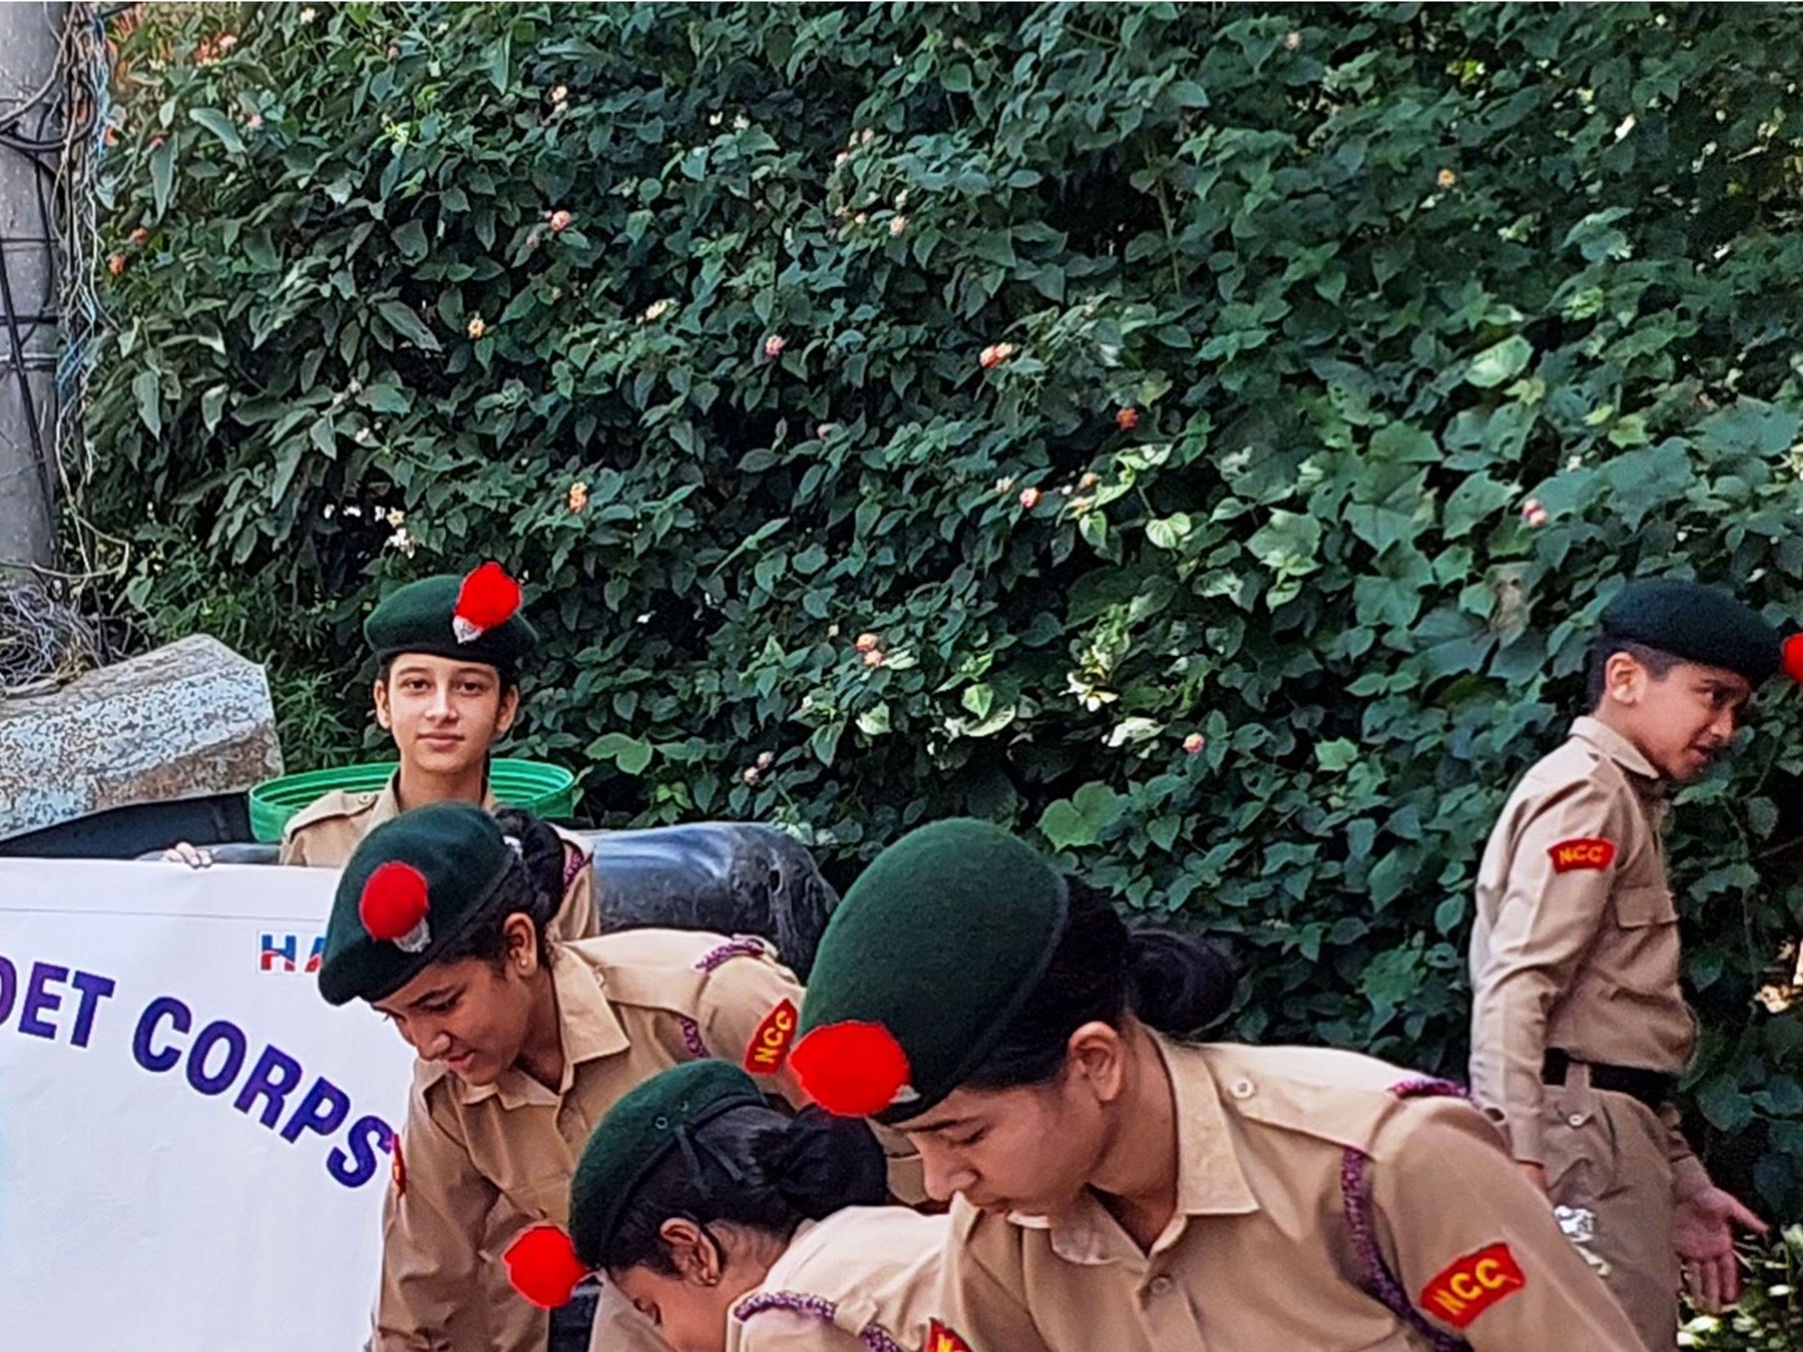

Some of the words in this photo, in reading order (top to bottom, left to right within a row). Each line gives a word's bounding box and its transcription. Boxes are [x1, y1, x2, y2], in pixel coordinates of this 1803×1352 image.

[1559, 844, 1605, 866] NCC
[753, 1009, 793, 1065] NCC
[131, 995, 395, 1189] CORPS
[1433, 1258, 1506, 1316] NCC
